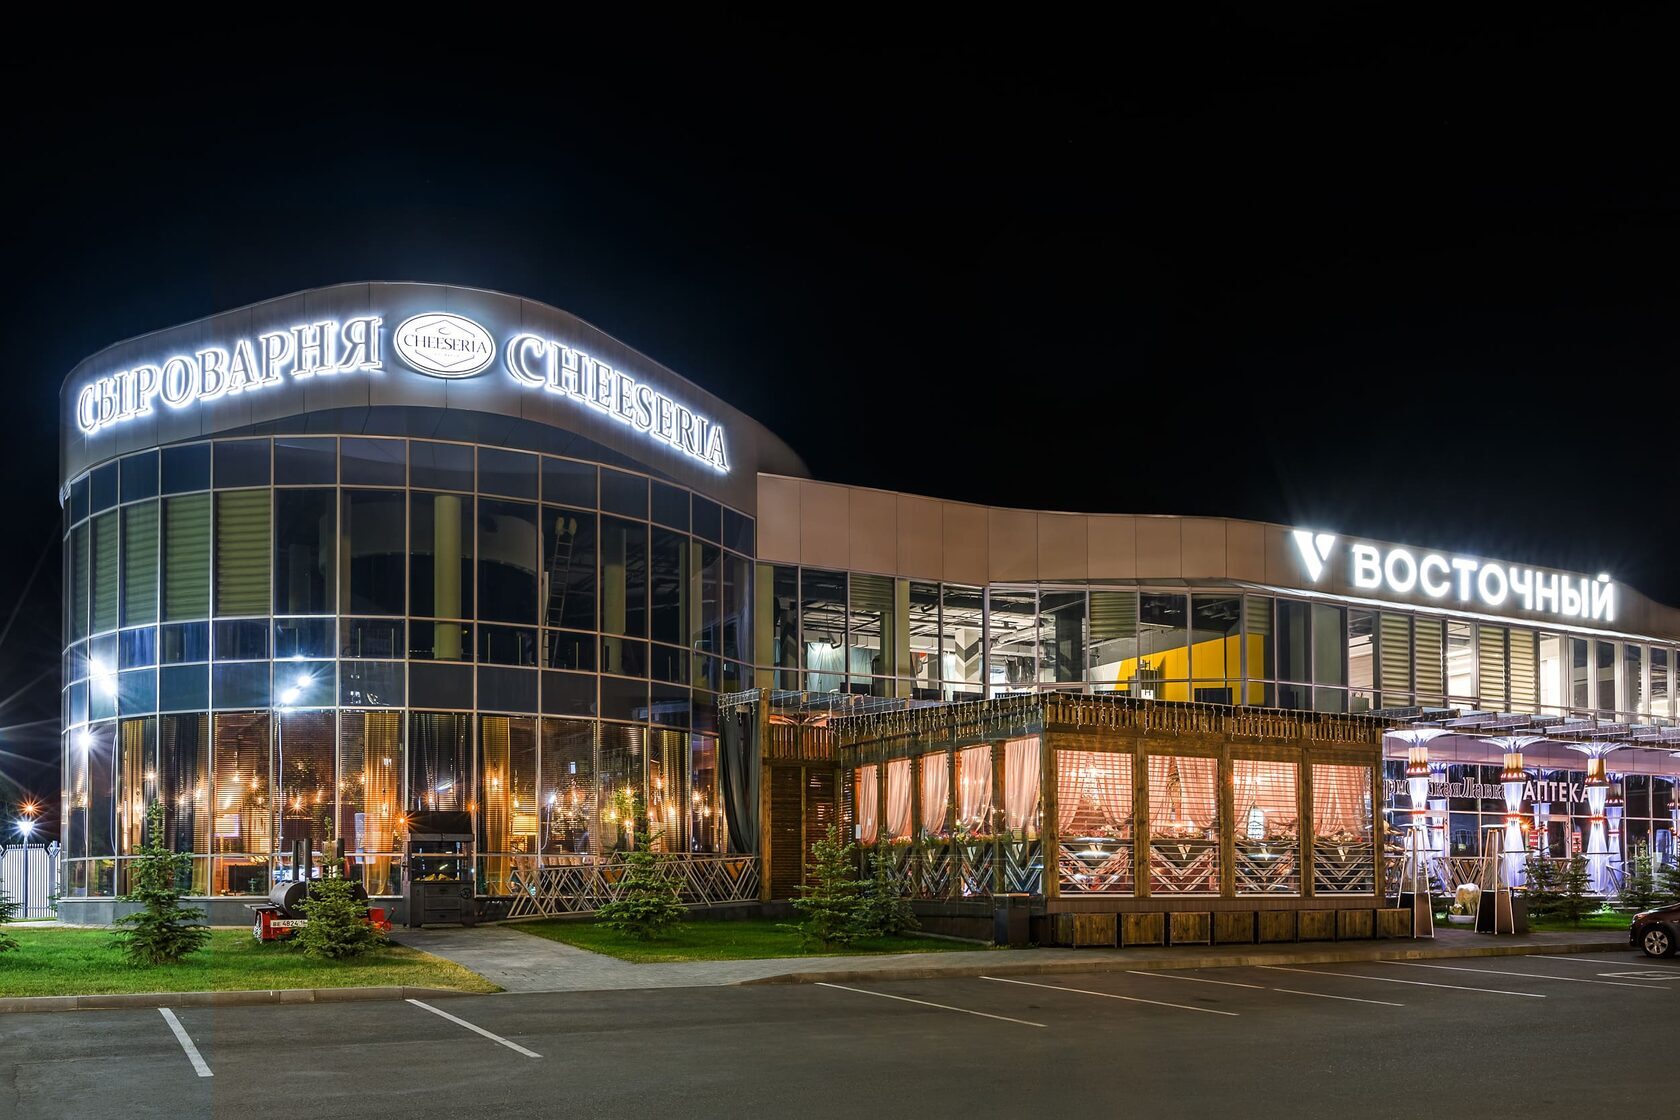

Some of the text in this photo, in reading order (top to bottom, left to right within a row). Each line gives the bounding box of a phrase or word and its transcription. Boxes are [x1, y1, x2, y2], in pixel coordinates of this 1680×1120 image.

[77, 317, 384, 433] СЫРОВАРНЯ
[403, 334, 487, 354] CHEESERIA
[504, 334, 731, 472] CHEESERIA
[1352, 543, 1615, 622] ВОСТОЧНЫЙ
[1460, 777, 1506, 800] Лавк
